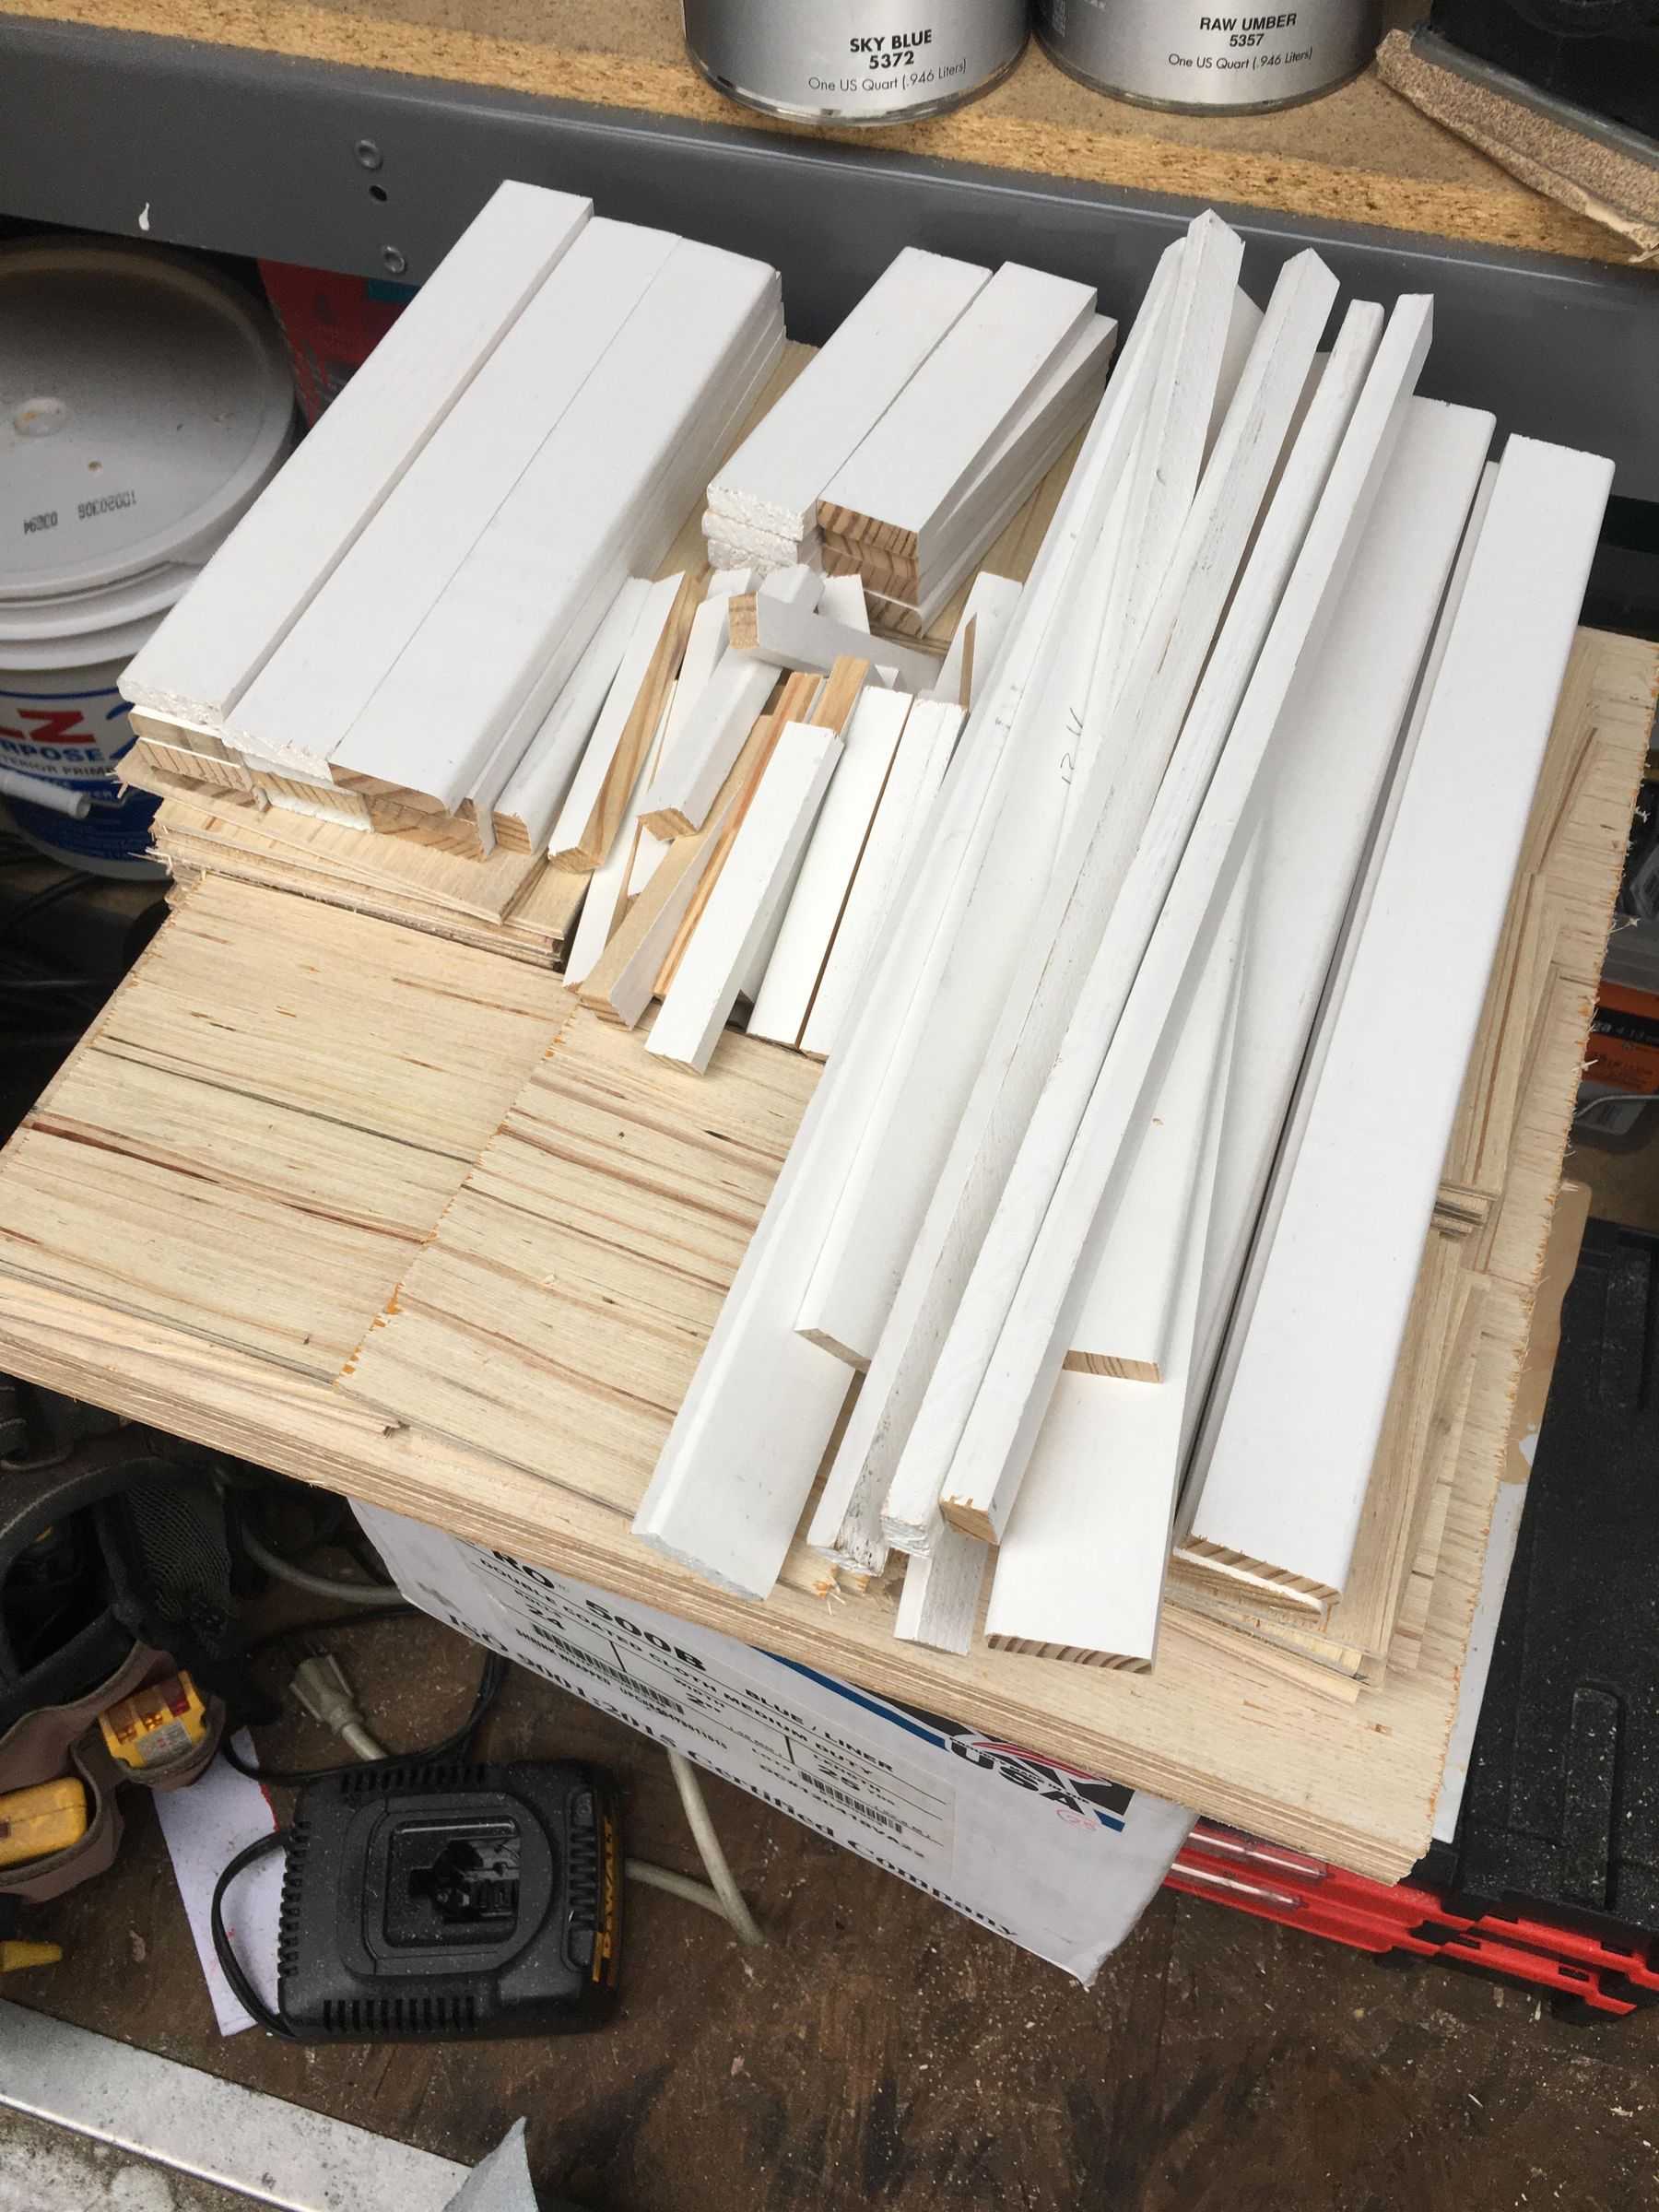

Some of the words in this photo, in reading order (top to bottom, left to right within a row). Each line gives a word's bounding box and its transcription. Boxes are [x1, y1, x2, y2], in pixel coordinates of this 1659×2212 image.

[1200, 17, 1237, 31] RAW
[1241, 13, 1297, 31] UMBER
[850, 37, 885, 53] SKY
[891, 29, 932, 50] BLUE
[1230, 33, 1265, 47] 5357
[808, 76, 835, 91] One
[840, 78, 857, 91] US
[862, 77, 898, 91] Quart
[902, 69, 934, 89] (.946
[938, 58, 967, 79] Liters)
[869, 51, 914, 69] 5372
[1169, 53, 1193, 67] One
[1197, 56, 1212, 69] US
[1217, 57, 1249, 69] Quart
[1253, 55, 1281, 70] (.946
[1285, 47, 1312, 64] Liters)
[0, 708, 96, 744] Z
[491, 1549, 555, 1588] RO
[585, 1599, 706, 1671] 500B
[525, 1604, 566, 1630] 24
[480, 1559, 556, 1606] DOUBLE
[563, 1606, 642, 1652] COATED
[649, 1653, 717, 1693] CLOTH
[724, 1693, 807, 1742] MEDIUM
[816, 1742, 872, 1774] DUTY
[515, 1628, 556, 1655] SHRINK
[559, 1653, 611, 1686] WRAPPED
[745, 1688, 804, 1724] BLUE
[825, 1732, 893, 1772] LINER
[450, 1614, 508, 1652] ISO
[688, 1750, 834, 1837] Certified
[847, 1840, 1018, 1936] Company
[818, 1764, 861, 1791] 25
[951, 1740, 1086, 1816] USA
